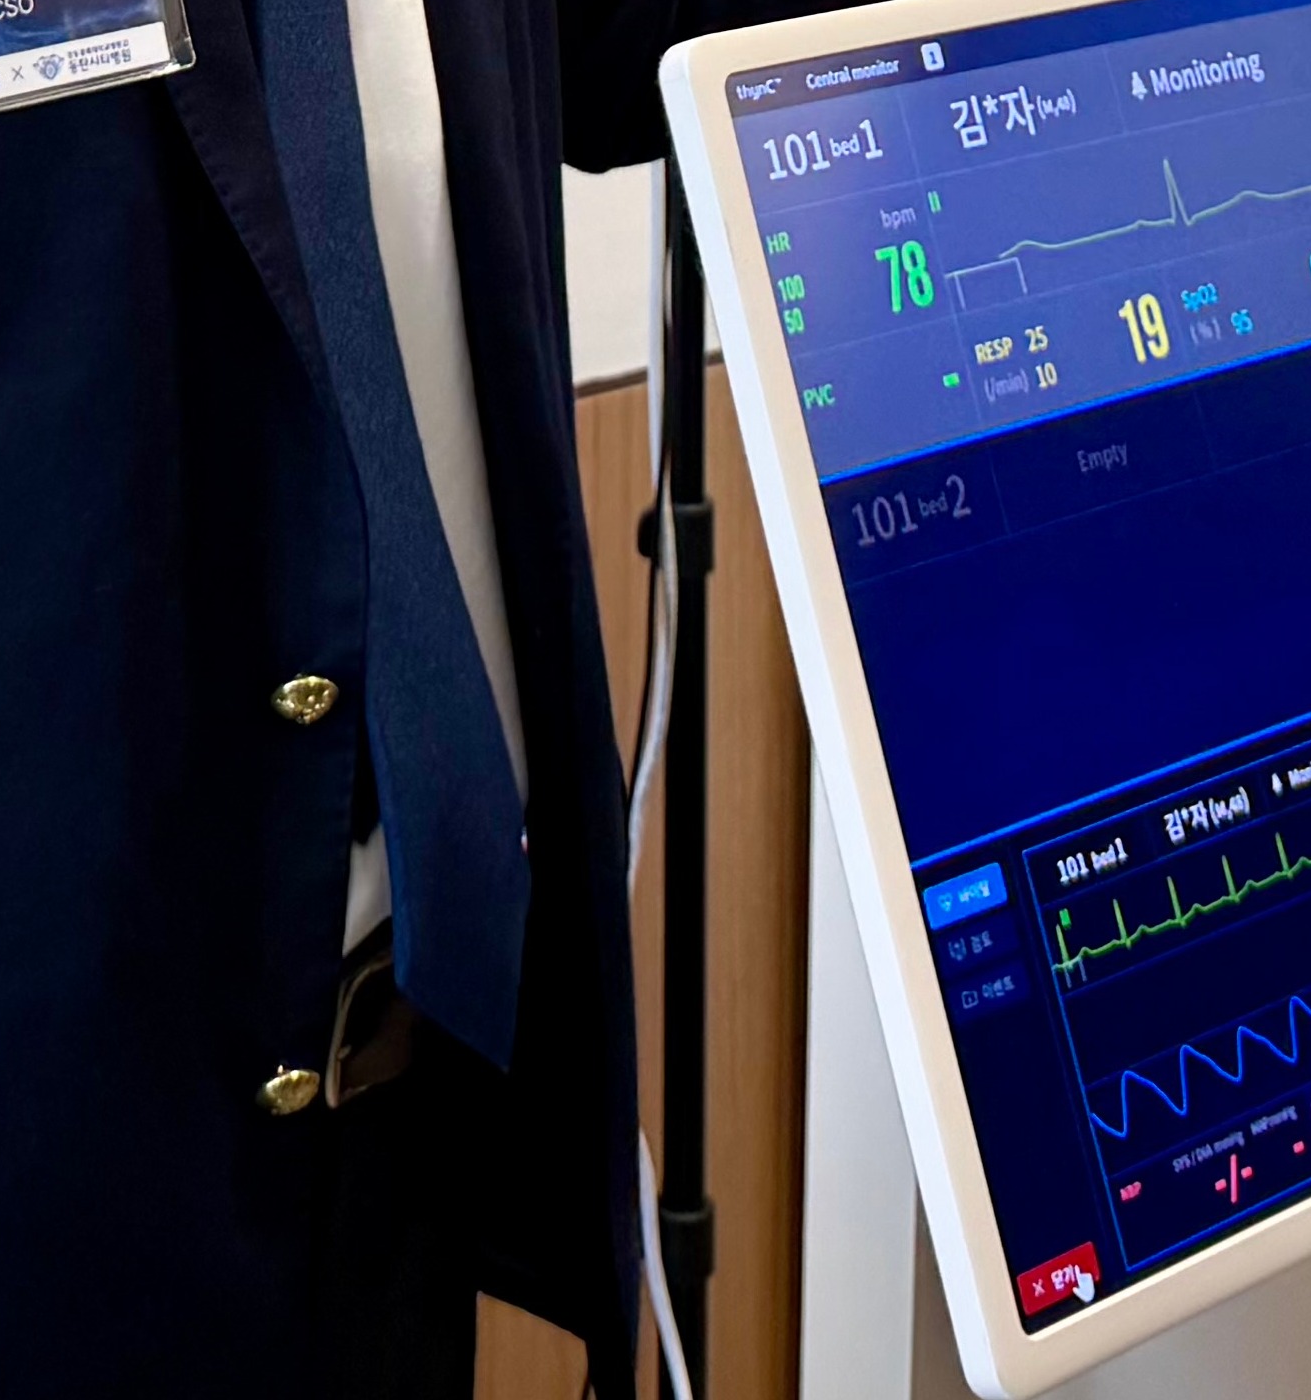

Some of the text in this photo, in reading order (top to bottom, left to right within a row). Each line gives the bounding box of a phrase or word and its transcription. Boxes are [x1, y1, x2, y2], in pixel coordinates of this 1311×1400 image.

[929, 51, 940, 66] 1
[806, 59, 901, 90] Central monitor
[1149, 51, 1266, 97] Monitoring
[880, 207, 917, 230] bpm
[766, 231, 791, 255] HR
[777, 274, 806, 303] 100
[874, 240, 935, 314] 78
[783, 307, 805, 334] 50
[1118, 293, 1170, 364] 19
[974, 326, 1048, 365] RESP 25
[1035, 362, 1058, 389] 10
[803, 383, 836, 411] PVC
[1077, 444, 1128, 473] Empty
[1057, 852, 1090, 885] 101
